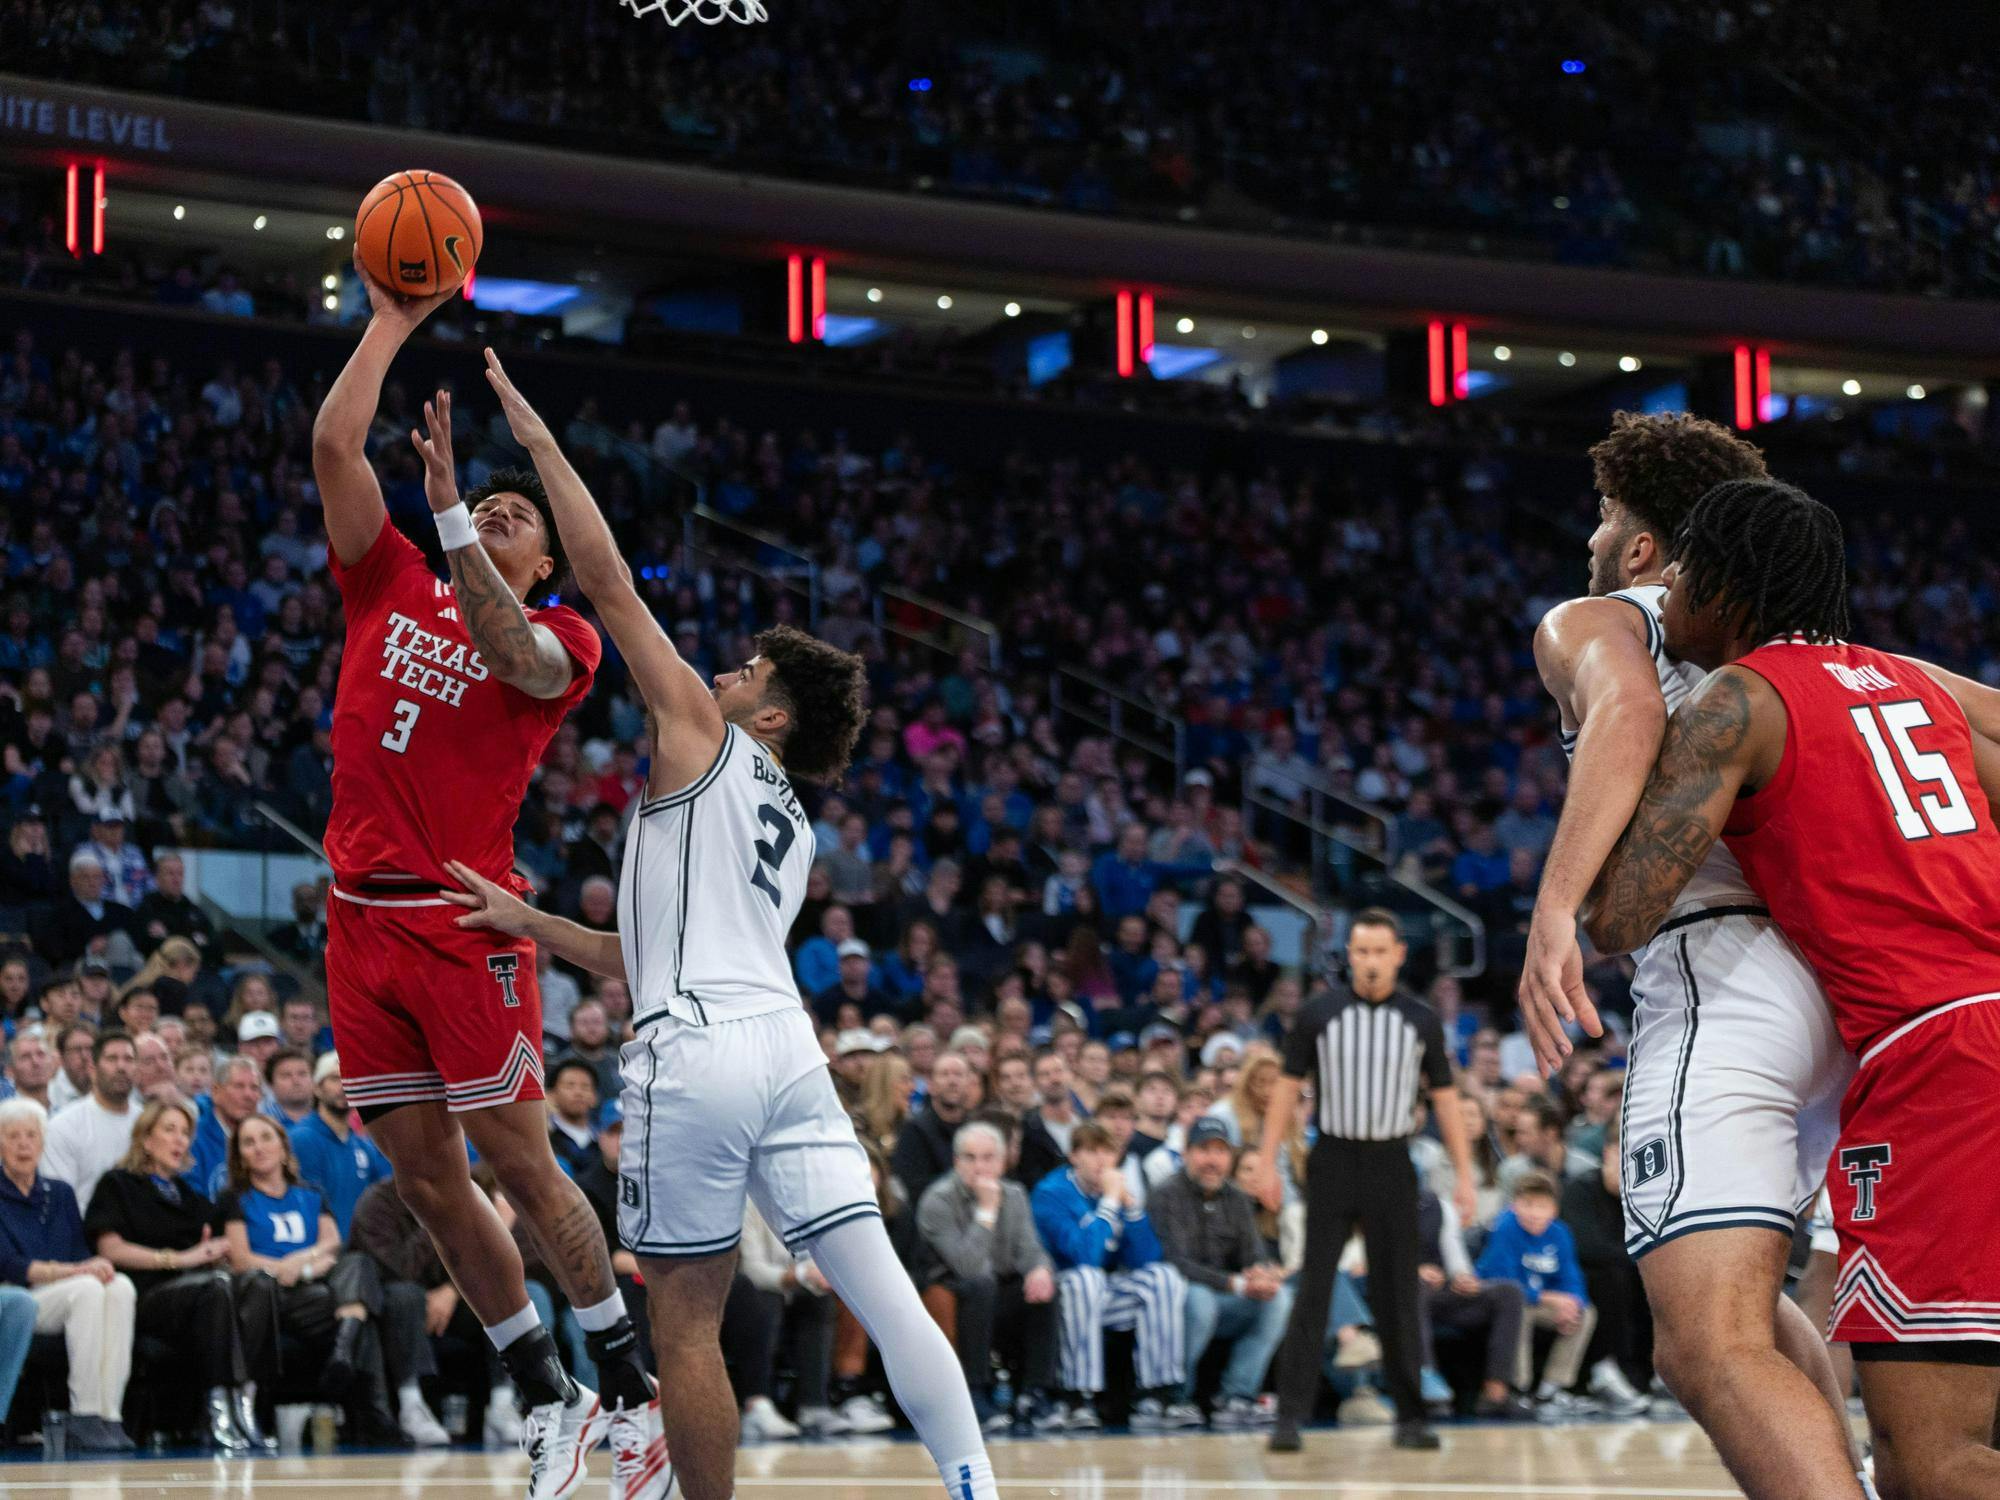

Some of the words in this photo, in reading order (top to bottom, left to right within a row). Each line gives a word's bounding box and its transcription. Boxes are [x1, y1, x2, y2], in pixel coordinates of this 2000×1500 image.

[67, 104, 171, 153] LEVEL
[380, 643, 469, 708] TECH
[384, 611, 490, 682] TEXAS
[380, 698, 421, 754] 3
[1848, 698, 1978, 841] 15
[750, 803, 796, 910] 2
